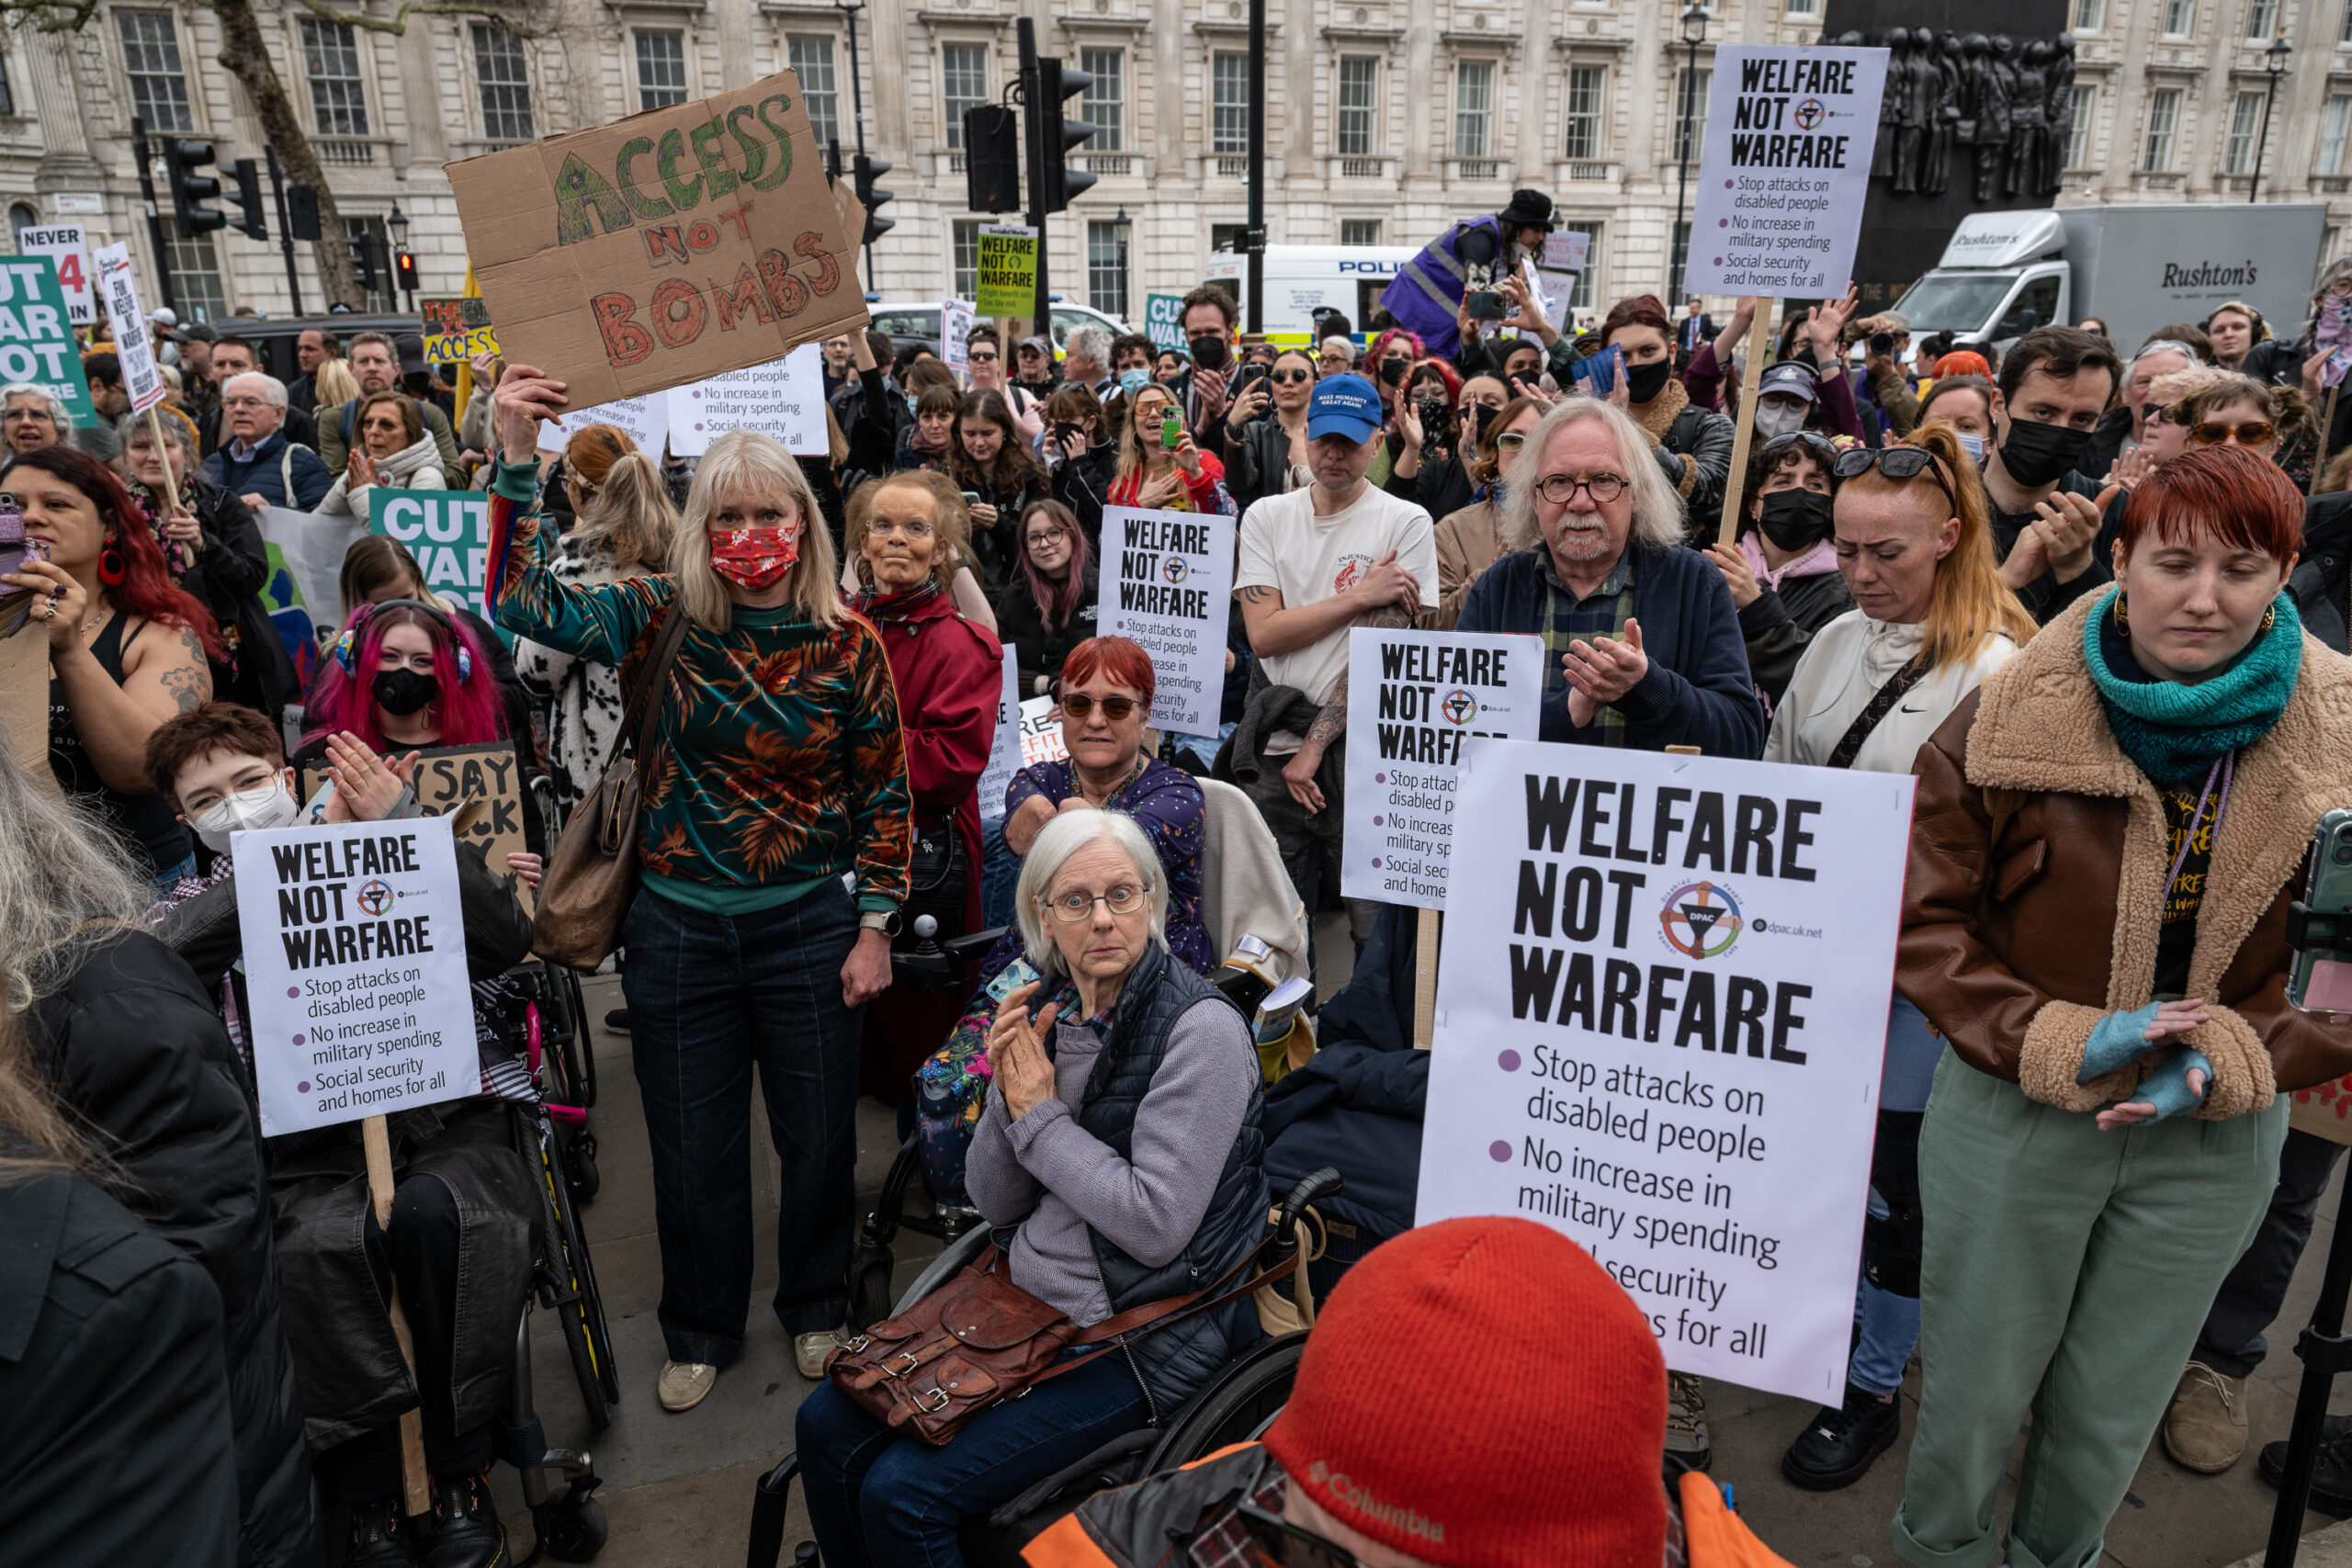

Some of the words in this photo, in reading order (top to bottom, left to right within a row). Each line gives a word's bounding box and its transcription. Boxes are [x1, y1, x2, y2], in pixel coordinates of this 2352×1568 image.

[1742, 59, 1857, 95] WELFARE
[1734, 96, 1790, 130] NOT
[1731, 133, 1849, 169] WARFARE
[554, 94, 793, 245] ACCESS
[1737, 175, 1765, 193] Stop
[1768, 176, 1811, 191] attacks
[1814, 180, 1829, 192] on
[1735, 193, 1785, 209] disabled
[1787, 195, 1829, 212] people
[640, 199, 754, 268] NOT
[1732, 214, 1748, 229] No
[1751, 216, 1801, 231] increase
[1804, 217, 1815, 231] in
[25, 230, 79, 246] NEVER
[981, 236, 1034, 255] WELFARE
[1729, 231, 1774, 251] military
[1776, 234, 1831, 253] spending
[981, 254, 1006, 269] NOT
[1339, 261, 1406, 273] POLI
[1726, 253, 1761, 268] Social
[1764, 255, 1811, 273] security
[2162, 259, 2256, 288] Rushton's
[980, 270, 1033, 288] WARFARE
[1723, 271, 1746, 285] and
[1748, 271, 1787, 286] homes
[1791, 272, 1807, 287] for
[1809, 273, 1824, 288] all
[424, 301, 462, 321] THE
[591, 231, 840, 367] BOMBS
[1150, 298, 1186, 323] CU
[0, 304, 64, 341] AR
[442, 321, 468, 337] IS
[0, 343, 67, 382] OT
[752, 369, 790, 384] people
[705, 387, 720, 399] No
[723, 388, 769, 399] increase
[772, 387, 782, 399] in
[1335, 394, 1367, 404] HUMANITY
[627, 414, 636, 425] in
[706, 401, 748, 416] military
[751, 401, 800, 416] spending
[790, 434, 802, 446] all
[1124, 518, 1210, 556] WELFARE
[1121, 550, 1159, 582] NOT
[1339, 553, 1374, 564] INJUSTICE
[1120, 581, 1208, 620] WARFARE
[1126, 618, 1147, 635] Stop
[1148, 622, 1182, 637] attacks
[1184, 627, 1196, 638] on
[1163, 642, 1197, 656] people
[1151, 660, 1176, 671] rease
[1179, 660, 1187, 672] in
[1381, 642, 1508, 687] WELFARE
[1158, 675, 1202, 693] spending
[1153, 694, 1186, 709] ecurity
[1378, 683, 1435, 722] NOT
[1150, 708, 1169, 720] mes
[1171, 708, 1185, 722] for
[1187, 711, 1199, 724] all
[433, 756, 514, 802] SAY
[1390, 770, 1418, 790] Stop
[1389, 789, 1442, 811] disabled
[1388, 812, 1406, 829] No
[1409, 816, 1453, 836] increas
[1524, 773, 1822, 883] WELFARE
[1386, 833, 1433, 856] military
[271, 834, 420, 885] WELFARE
[1385, 854, 1421, 875] Social
[1384, 876, 1408, 892] and
[1411, 877, 1446, 898] home
[1661, 877, 1691, 903] Disabled
[277, 883, 347, 928] NOT
[1513, 860, 1646, 949] NOT
[1690, 912, 1714, 922] DPAC
[1768, 921, 1823, 939] dpac.uk.net
[281, 915, 434, 971] WARFARE
[1723, 944, 1739, 958] Cuts
[305, 978, 342, 997] Stop
[346, 968, 400, 990] attacks
[403, 968, 421, 982] on
[308, 992, 374, 1018] disabled
[379, 985, 425, 1010] people
[1510, 943, 1813, 1066] WARFARE
[311, 1025, 334, 1043] No
[337, 1018, 401, 1039] increase
[403, 1012, 416, 1028] in
[313, 1043, 372, 1066] military
[377, 1030, 442, 1056] spending
[315, 1066, 363, 1090] Social
[368, 1057, 424, 1081] security
[1531, 1044, 1597, 1093] Stop
[1604, 1065, 1714, 1109] attacks
[1724, 1088, 1764, 1117] on
[318, 1090, 347, 1112] and
[352, 1084, 403, 1105] homes
[406, 1077, 425, 1095] for
[429, 1070, 446, 1090] all
[1526, 1087, 1648, 1143] disabled
[1657, 1123, 1766, 1164] people
[1522, 1134, 1563, 1174] No
[1571, 1147, 1694, 1203] increase
[1704, 1173, 1732, 1210] in
[1518, 1183, 1625, 1240] military
[1634, 1214, 1781, 1270] spending
[1605, 1258, 1727, 1312] security
[1677, 1308, 1722, 1349] for
[1729, 1323, 1768, 1359] all
[1329, 1472, 1445, 1542] Columbia
